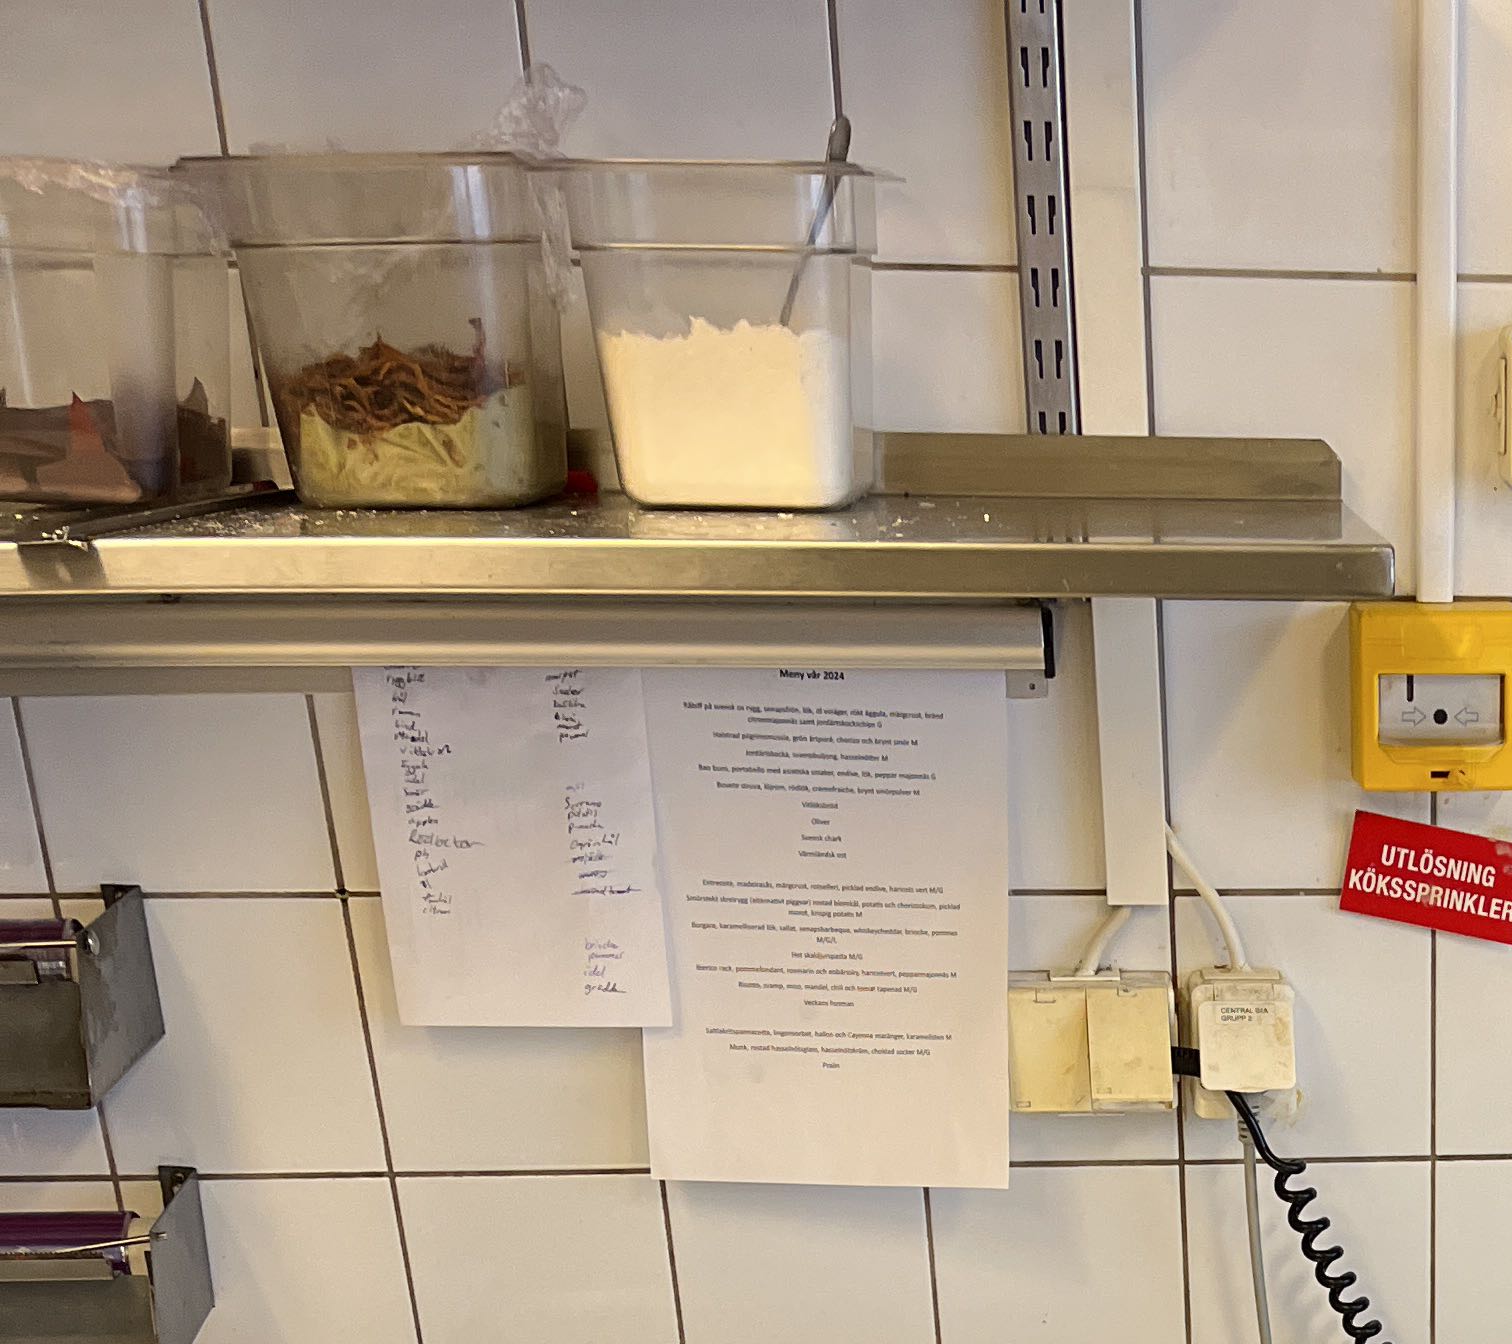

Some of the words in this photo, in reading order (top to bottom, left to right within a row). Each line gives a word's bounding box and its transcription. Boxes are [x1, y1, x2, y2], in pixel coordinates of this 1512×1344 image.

[779, 669, 804, 680] Meny
[823, 670, 844, 680] 2024
[1381, 844, 1496, 888] UTLÖSNING
